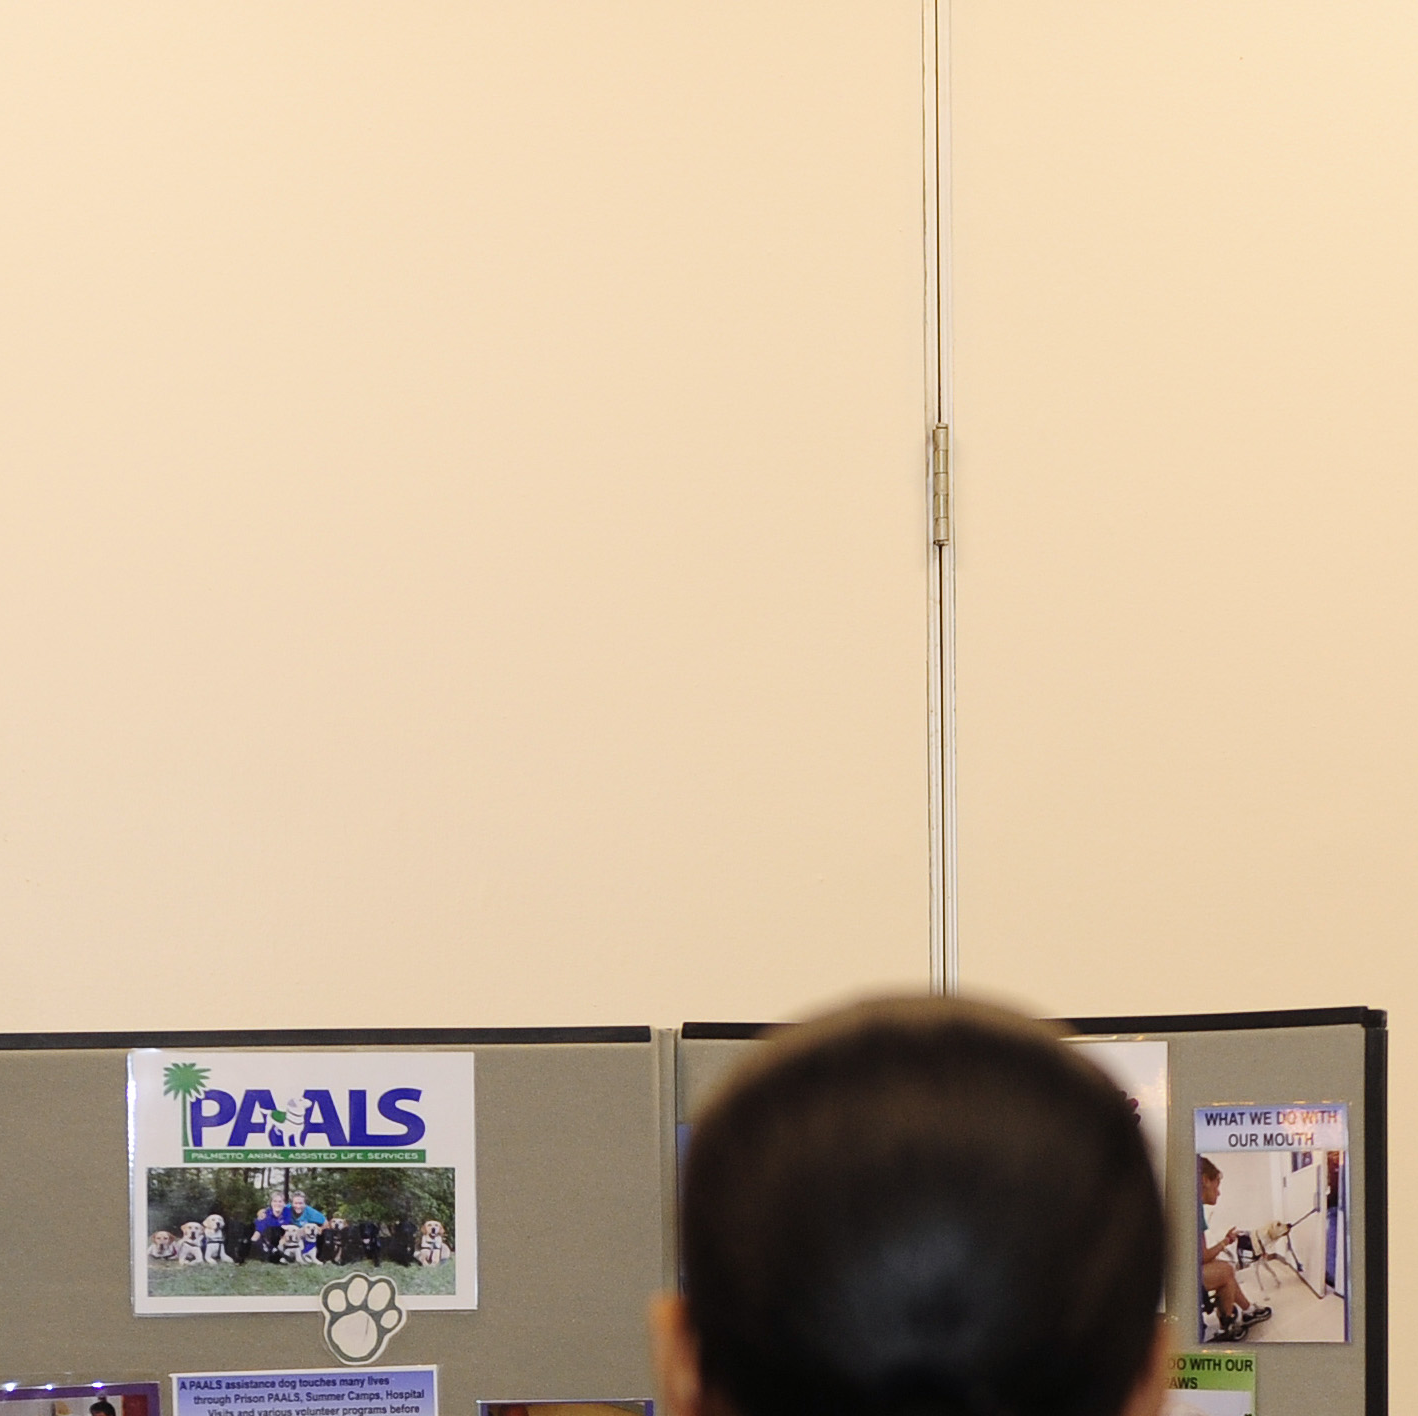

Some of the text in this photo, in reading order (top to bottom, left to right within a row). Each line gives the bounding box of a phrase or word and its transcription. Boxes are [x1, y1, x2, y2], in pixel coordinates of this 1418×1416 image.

[190, 1087, 426, 1147] PAALS
[1205, 1110, 1338, 1126] WHAT WE DO WITH
[1228, 1132, 1314, 1147] OUR MOUTH
[191, 1152, 419, 1160] PALMETTO ANIMAL ASSISTED LIFE SERVICES
[1189, 1358, 1221, 1371] WITH
[1224, 1359, 1253, 1372] OUR
[180, 1376, 390, 1391] A PAALS assistance dog touches many lives
[1168, 1376, 1198, 1389] AWS
[193, 1395, 231, 1406] through
[233, 1393, 265, 1403] Prison
[267, 1392, 303, 1403] PAALS,
[305, 1392, 345, 1402] Summer
[385, 1389, 425, 1400] Hospital
[257, 1408, 292, 1416] various
[295, 1406, 340, 1416] volunteer
[342, 1405, 387, 1416] programs
[389, 1404, 420, 1413] before
